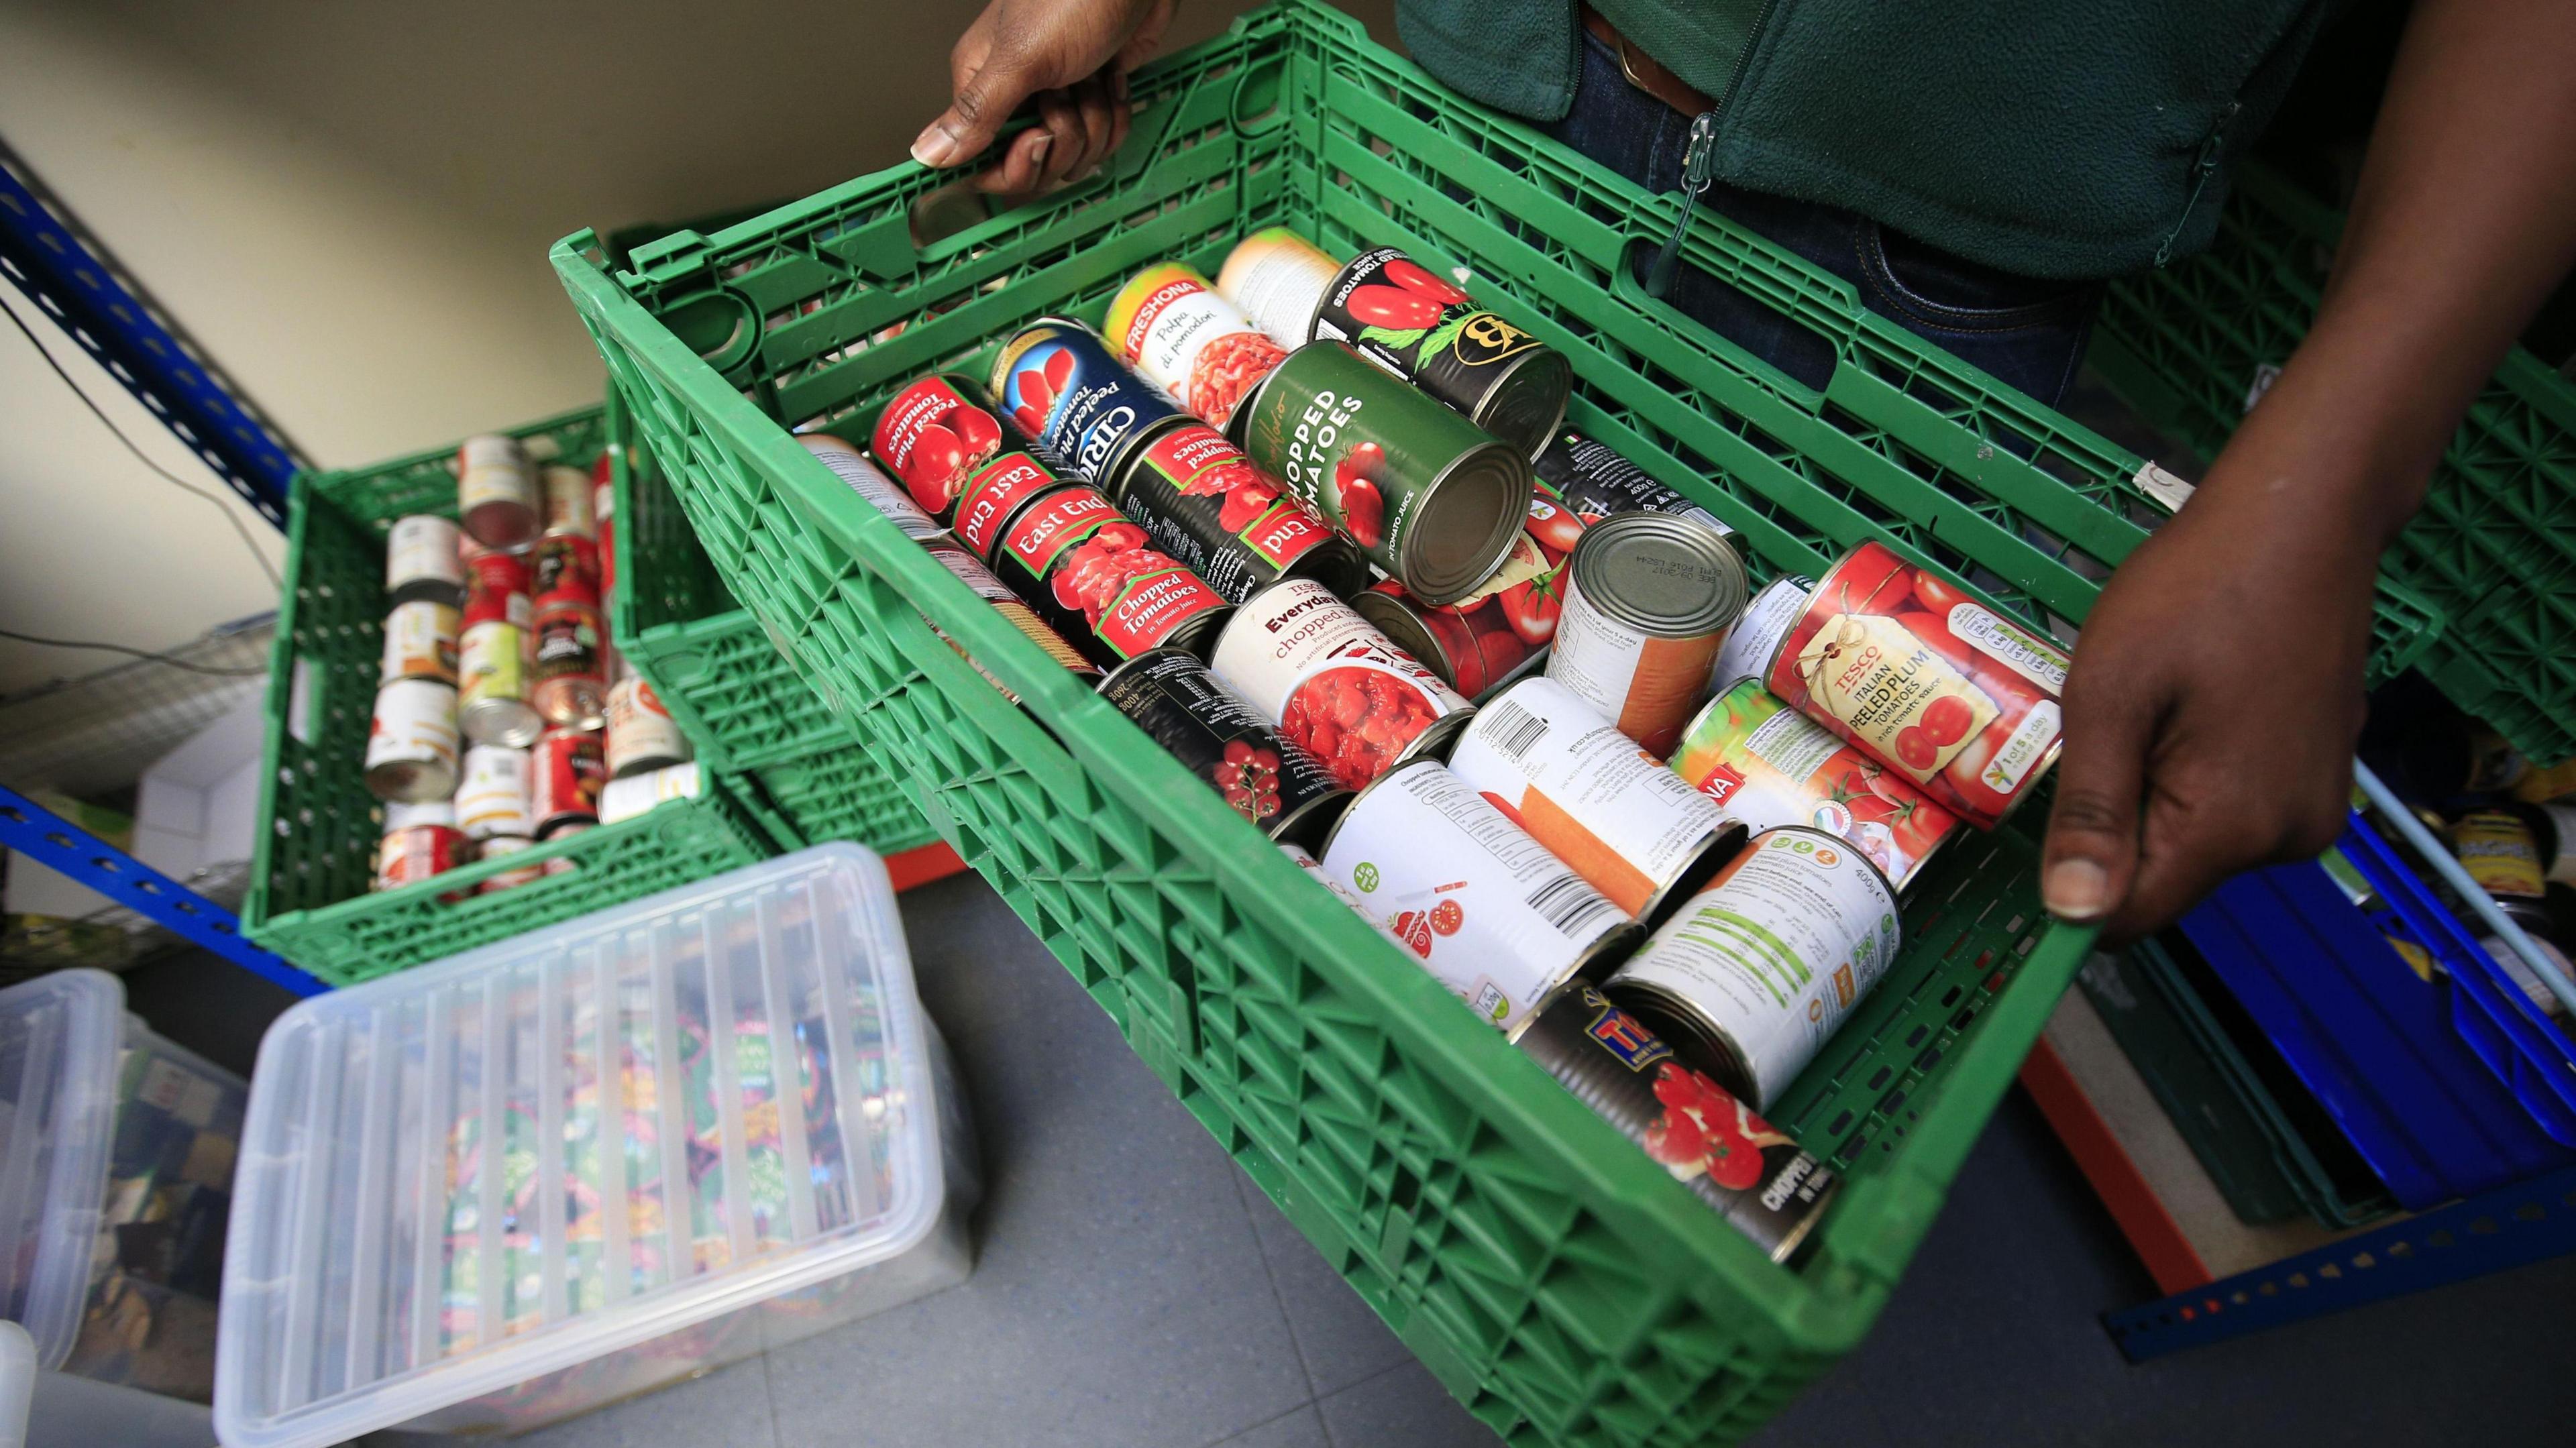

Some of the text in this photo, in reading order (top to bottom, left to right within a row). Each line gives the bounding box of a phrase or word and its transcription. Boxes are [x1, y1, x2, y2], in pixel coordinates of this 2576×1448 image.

[1352, 254, 1374, 270] JUICE
[1333, 261, 1382, 307] TOMATOES
[1127, 282, 1197, 351] FRESHONA
[1155, 311, 1189, 341] Polpa
[1161, 310, 1217, 370] di pomodori
[888, 393, 943, 453] Tomatoes
[1073, 381, 1120, 433] Peeled
[895, 398, 959, 469] Peeled Plum
[1303, 396, 1362, 522] OMATOES
[966, 465, 1040, 546] East End
[1629, 481, 1648, 496] 400g
[1018, 512, 1065, 555] East
[1060, 496, 1107, 516] End
[1263, 520, 1311, 553] End
[1389, 490, 1415, 562] IN TOMATO JUICE
[1117, 573, 1183, 620] Chopped
[1122, 583, 1198, 636] Tomatoes
[1147, 597, 1198, 634] in Tomato Juice
[1265, 595, 1336, 633] Everyday
[1275, 610, 1340, 659] chopped
[1305, 638, 1334, 665] artificial
[1311, 624, 1343, 643] Produced
[1600, 625, 1614, 634] your
[1617, 633, 1637, 647] a-day
[1994, 634, 2007, 648] 0.4g
[1746, 637, 1772, 672] Organic Tomato
[1834, 645, 1879, 689] TESCO
[1108, 682, 1130, 702] 260g
[1119, 692, 1140, 712] 400g
[1849, 650, 1930, 730] PEELED PLUM
[1854, 664, 1892, 703] ITALIAN
[1874, 680, 1921, 726] TOMATOES
[1882, 721, 1894, 738] rich
[1892, 700, 1919, 727] tomato
[1919, 677, 1943, 701] sauce
[2002, 713, 2048, 766] 1 of 5 a day
[2016, 751, 2029, 765] half
[2025, 743, 2035, 753] of
[2036, 726, 2049, 739] can
[1401, 773, 1421, 787] Chopped
[1670, 839, 1682, 853] your
[1778, 856, 1799, 872] plum
[1799, 865, 1833, 887] tomatoes
[1784, 864, 1803, 878] juice
[1855, 867, 1876, 893] 400g
